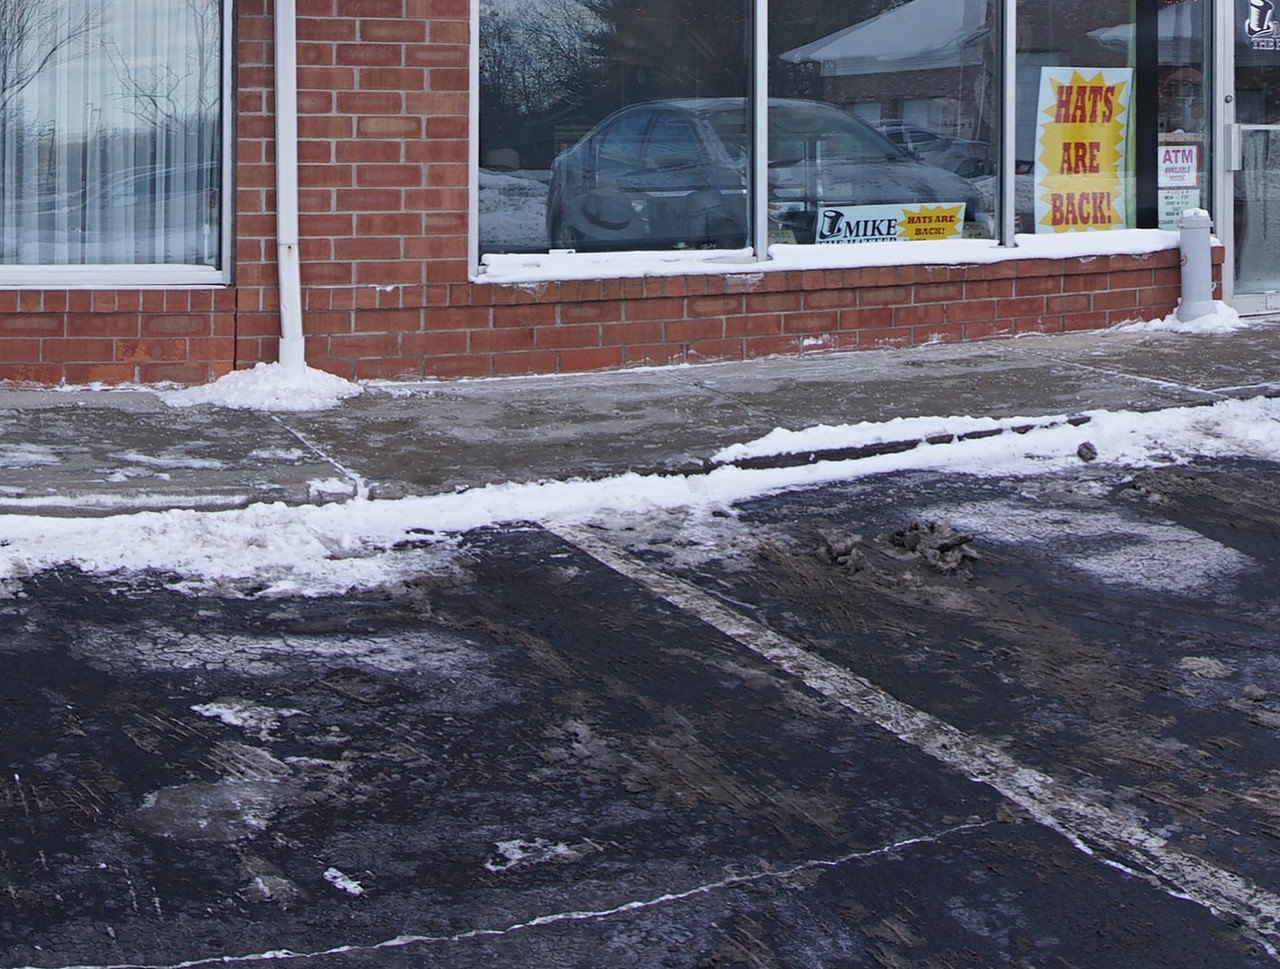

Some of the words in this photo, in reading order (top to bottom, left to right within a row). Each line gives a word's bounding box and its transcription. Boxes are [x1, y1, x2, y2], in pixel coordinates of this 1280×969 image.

[1251, 37, 1275, 50] THE
[1054, 85, 1115, 124] HATS
[1060, 141, 1101, 175] ARE
[1162, 149, 1194, 164] ATM
[1051, 192, 1112, 226] BACK!
[843, 218, 898, 239] MIKE
[907, 215, 933, 224] HATS
[934, 215, 956, 223] ARE
[914, 227, 946, 236] BACK!
